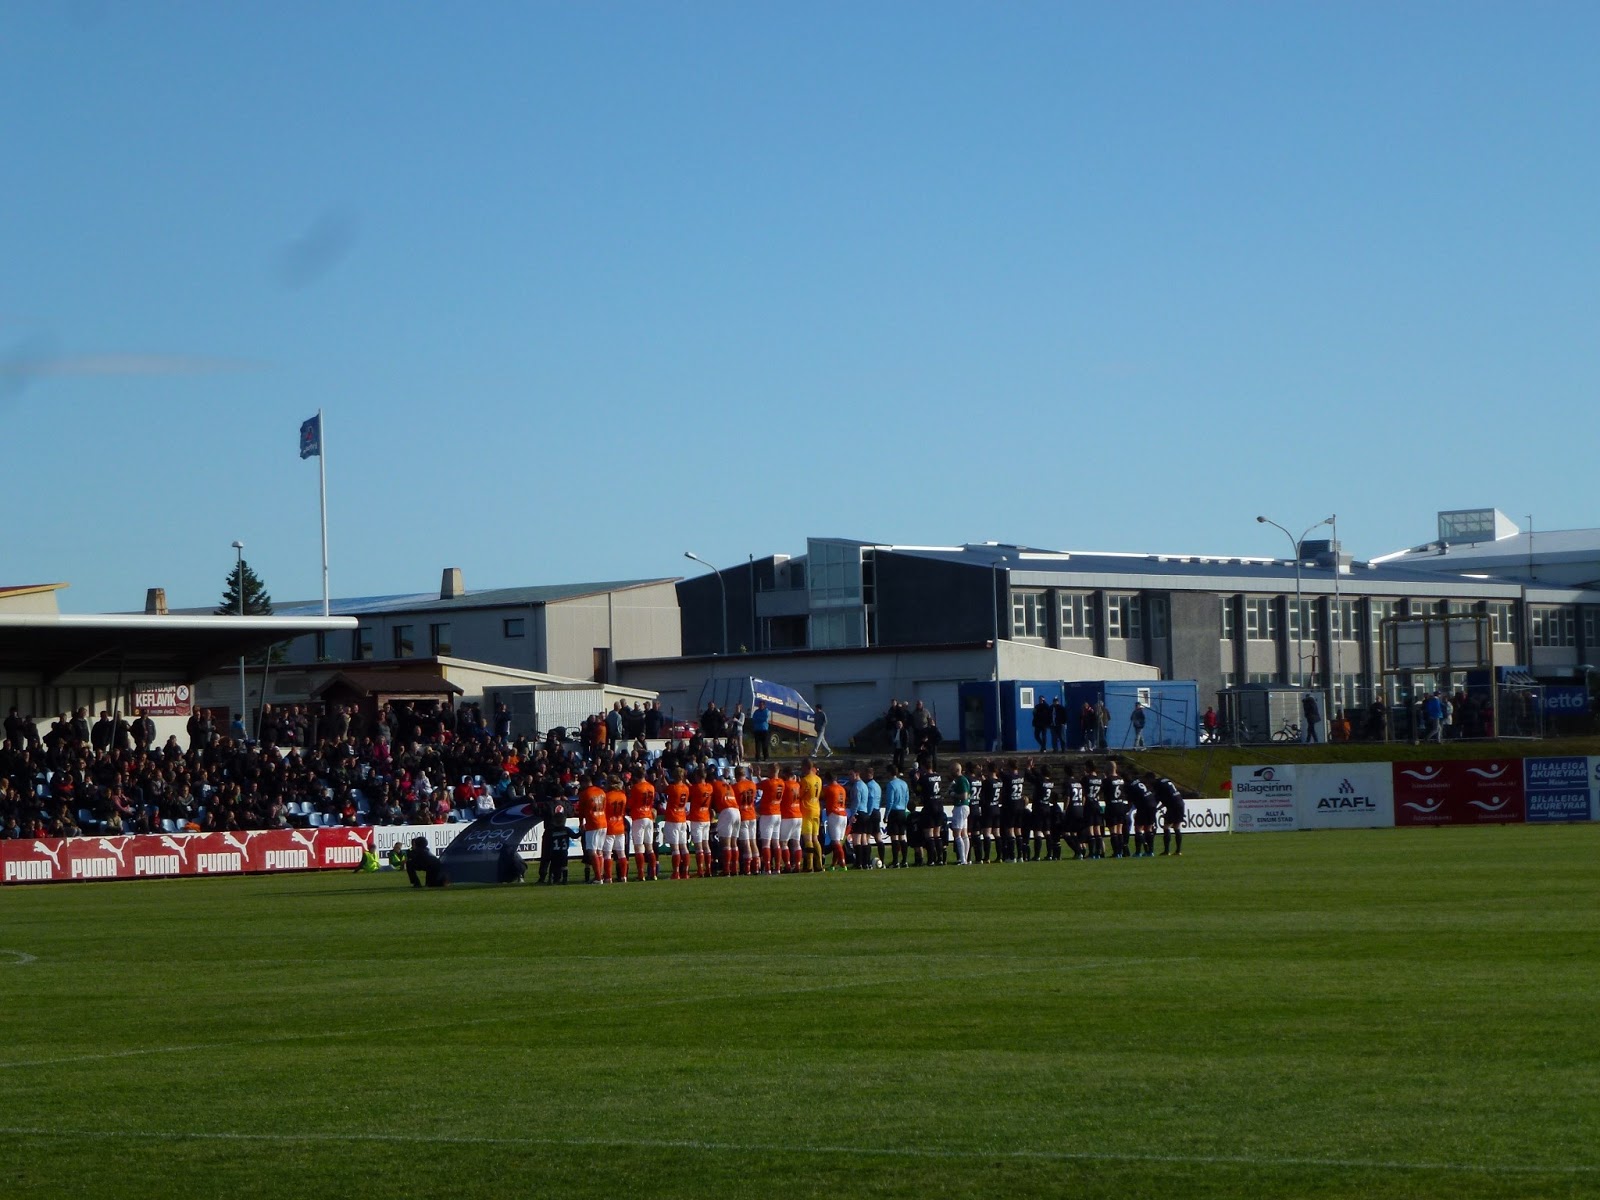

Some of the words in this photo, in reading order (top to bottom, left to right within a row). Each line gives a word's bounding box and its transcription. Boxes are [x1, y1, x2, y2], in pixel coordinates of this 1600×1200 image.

[1530, 769, 1587, 778] AKUREYRAR
[1317, 797, 1376, 809] ATAFL
[1529, 801, 1587, 810] AKUREYRAR
[377, 833, 395, 849] BLUE
[396, 831, 427, 849] LAG
[197, 852, 241, 873] PUMA
[265, 849, 308, 869] PUMA
[325, 846, 363, 864] PUMA
[5, 860, 52, 881] PUMA
[71, 857, 117, 878] PUMA
[134, 855, 179, 875] PUMA
